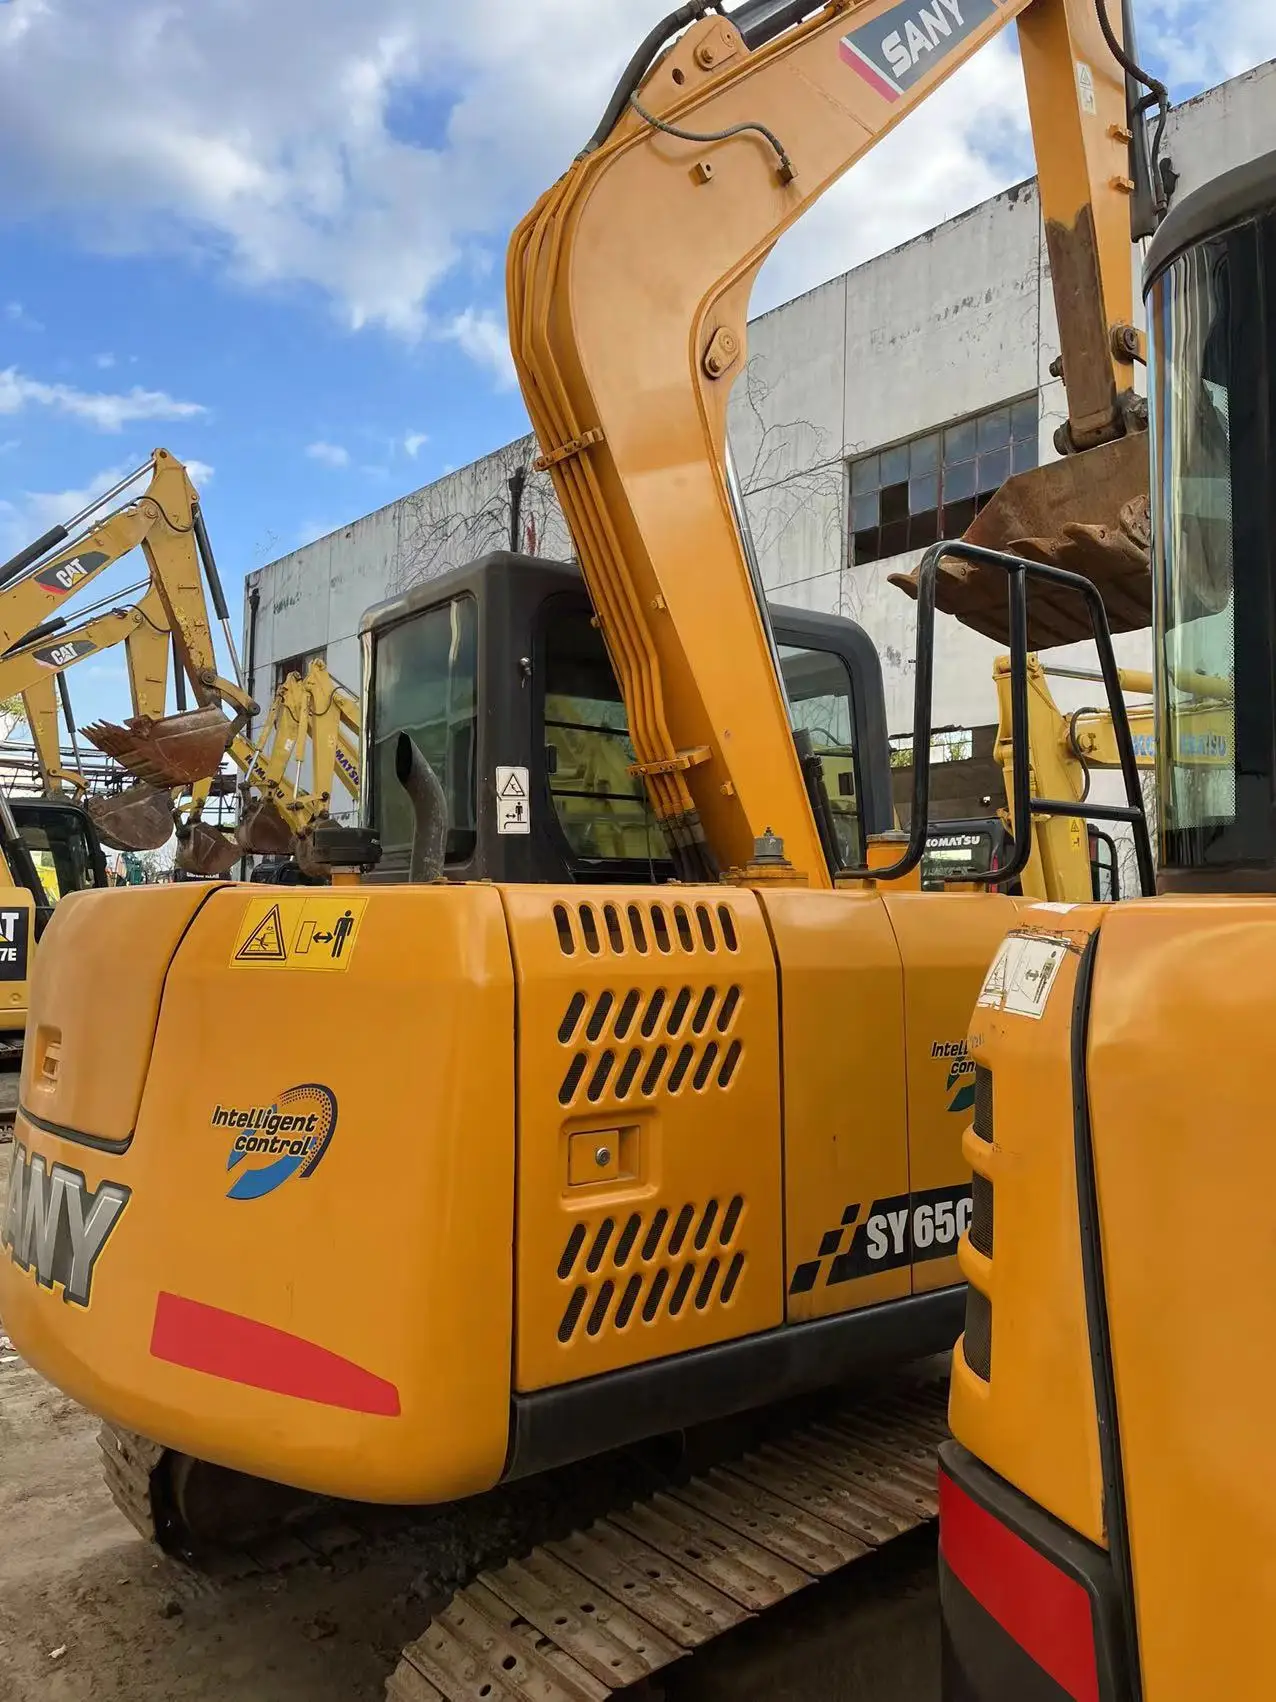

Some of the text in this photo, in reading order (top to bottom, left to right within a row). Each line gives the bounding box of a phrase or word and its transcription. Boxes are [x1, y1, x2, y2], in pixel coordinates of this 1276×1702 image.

[881, 0, 965, 78] SANY
[56, 558, 88, 588] CAT
[50, 642, 79, 665] CAT
[211, 1104, 320, 1136] Intelligent
[234, 1134, 312, 1157] control
